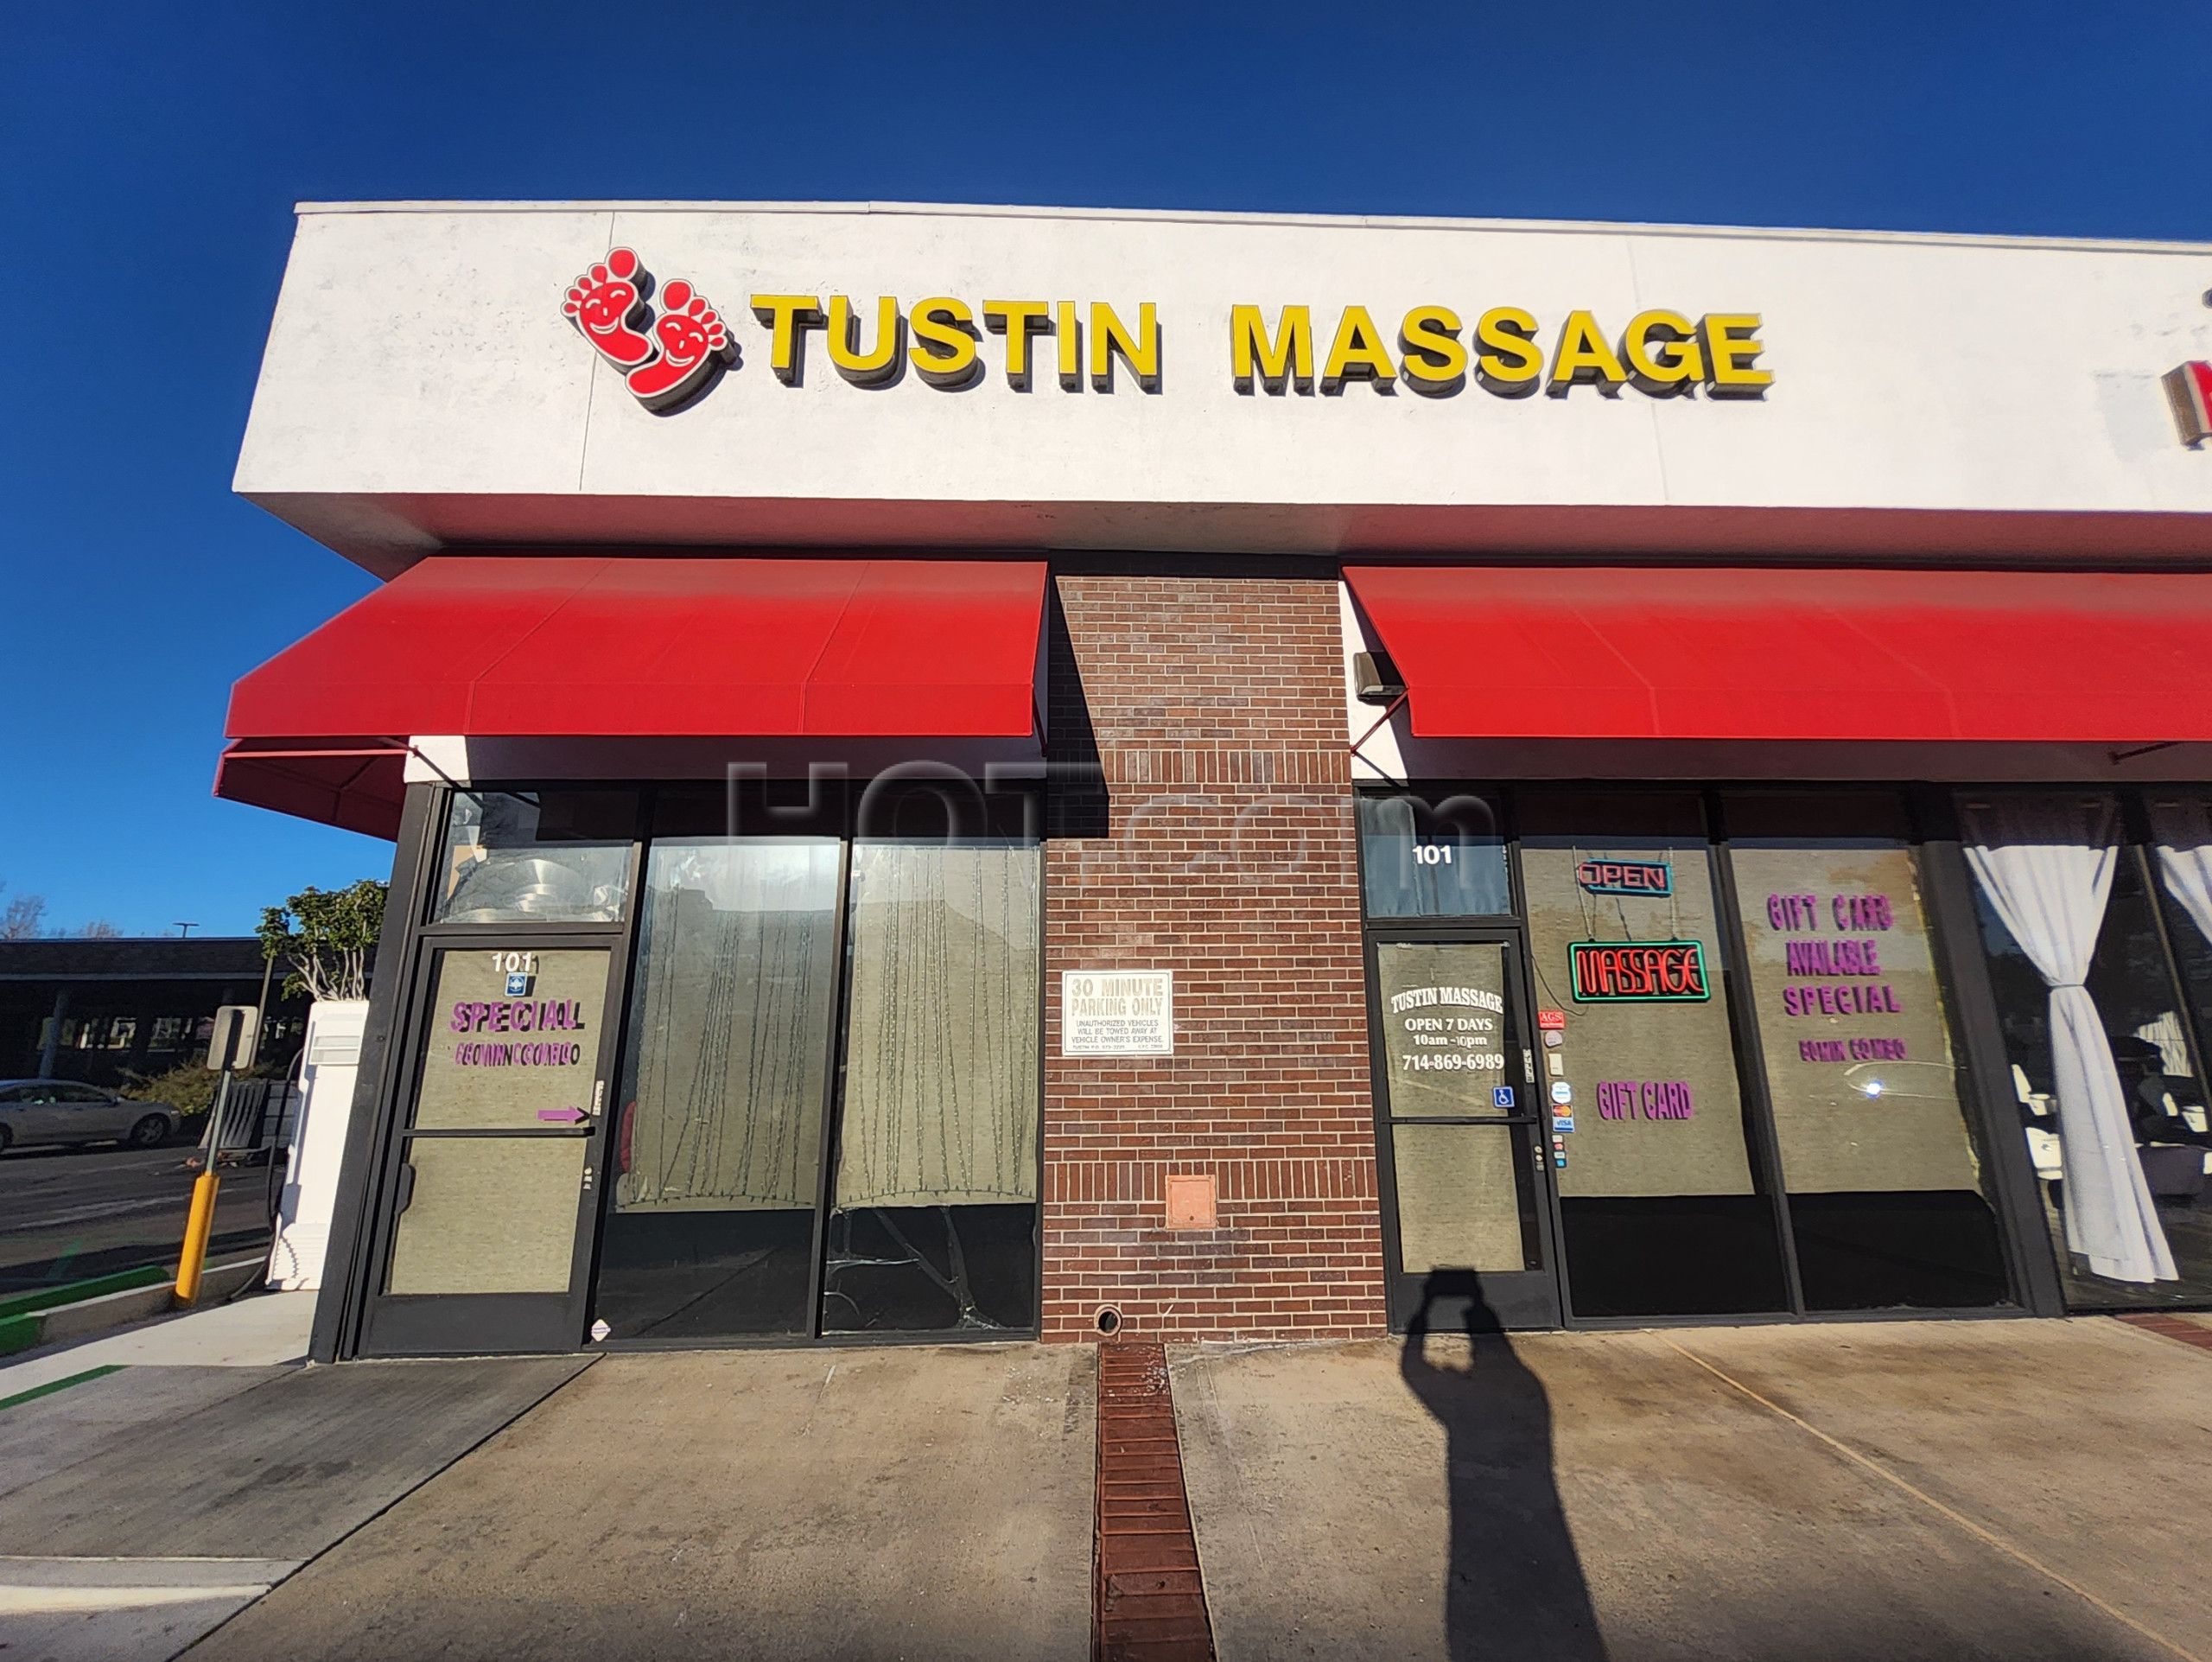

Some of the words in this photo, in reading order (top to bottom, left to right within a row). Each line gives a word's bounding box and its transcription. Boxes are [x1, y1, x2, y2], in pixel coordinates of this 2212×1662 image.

[750, 294, 1158, 380] TUSTIN
[1231, 303, 1774, 387] MASSAGE
[1412, 845, 1452, 864] 101
[1579, 864, 1665, 888] OPEN
[1768, 894, 1817, 931] GIFT
[1833, 894, 1894, 931] CARD
[493, 952, 532, 972] 101
[1576, 949, 1705, 993] MASSAGE
[1071, 978, 1094, 997] 30
[1102, 977, 1164, 997] MINUTE
[1071, 997, 1126, 1016] PARKING
[1132, 997, 1163, 1016] ONLY
[1390, 986, 1438, 1014] TUSTIN
[1439, 986, 1503, 1015] MASSAGE
[1783, 984, 1903, 1016] SPECIAL
[450, 999, 577, 1032] SPECIAL
[1404, 1018, 1443, 1031] OPEN
[1446, 1018, 1454, 1031] 7
[1457, 1018, 1493, 1031] DAYS
[1413, 1035, 1448, 1046] 10am
[1402, 1054, 1505, 1071] 714-869-6989
[1597, 1080, 1638, 1120] GIFT
[1641, 1080, 1692, 1120] CARD
